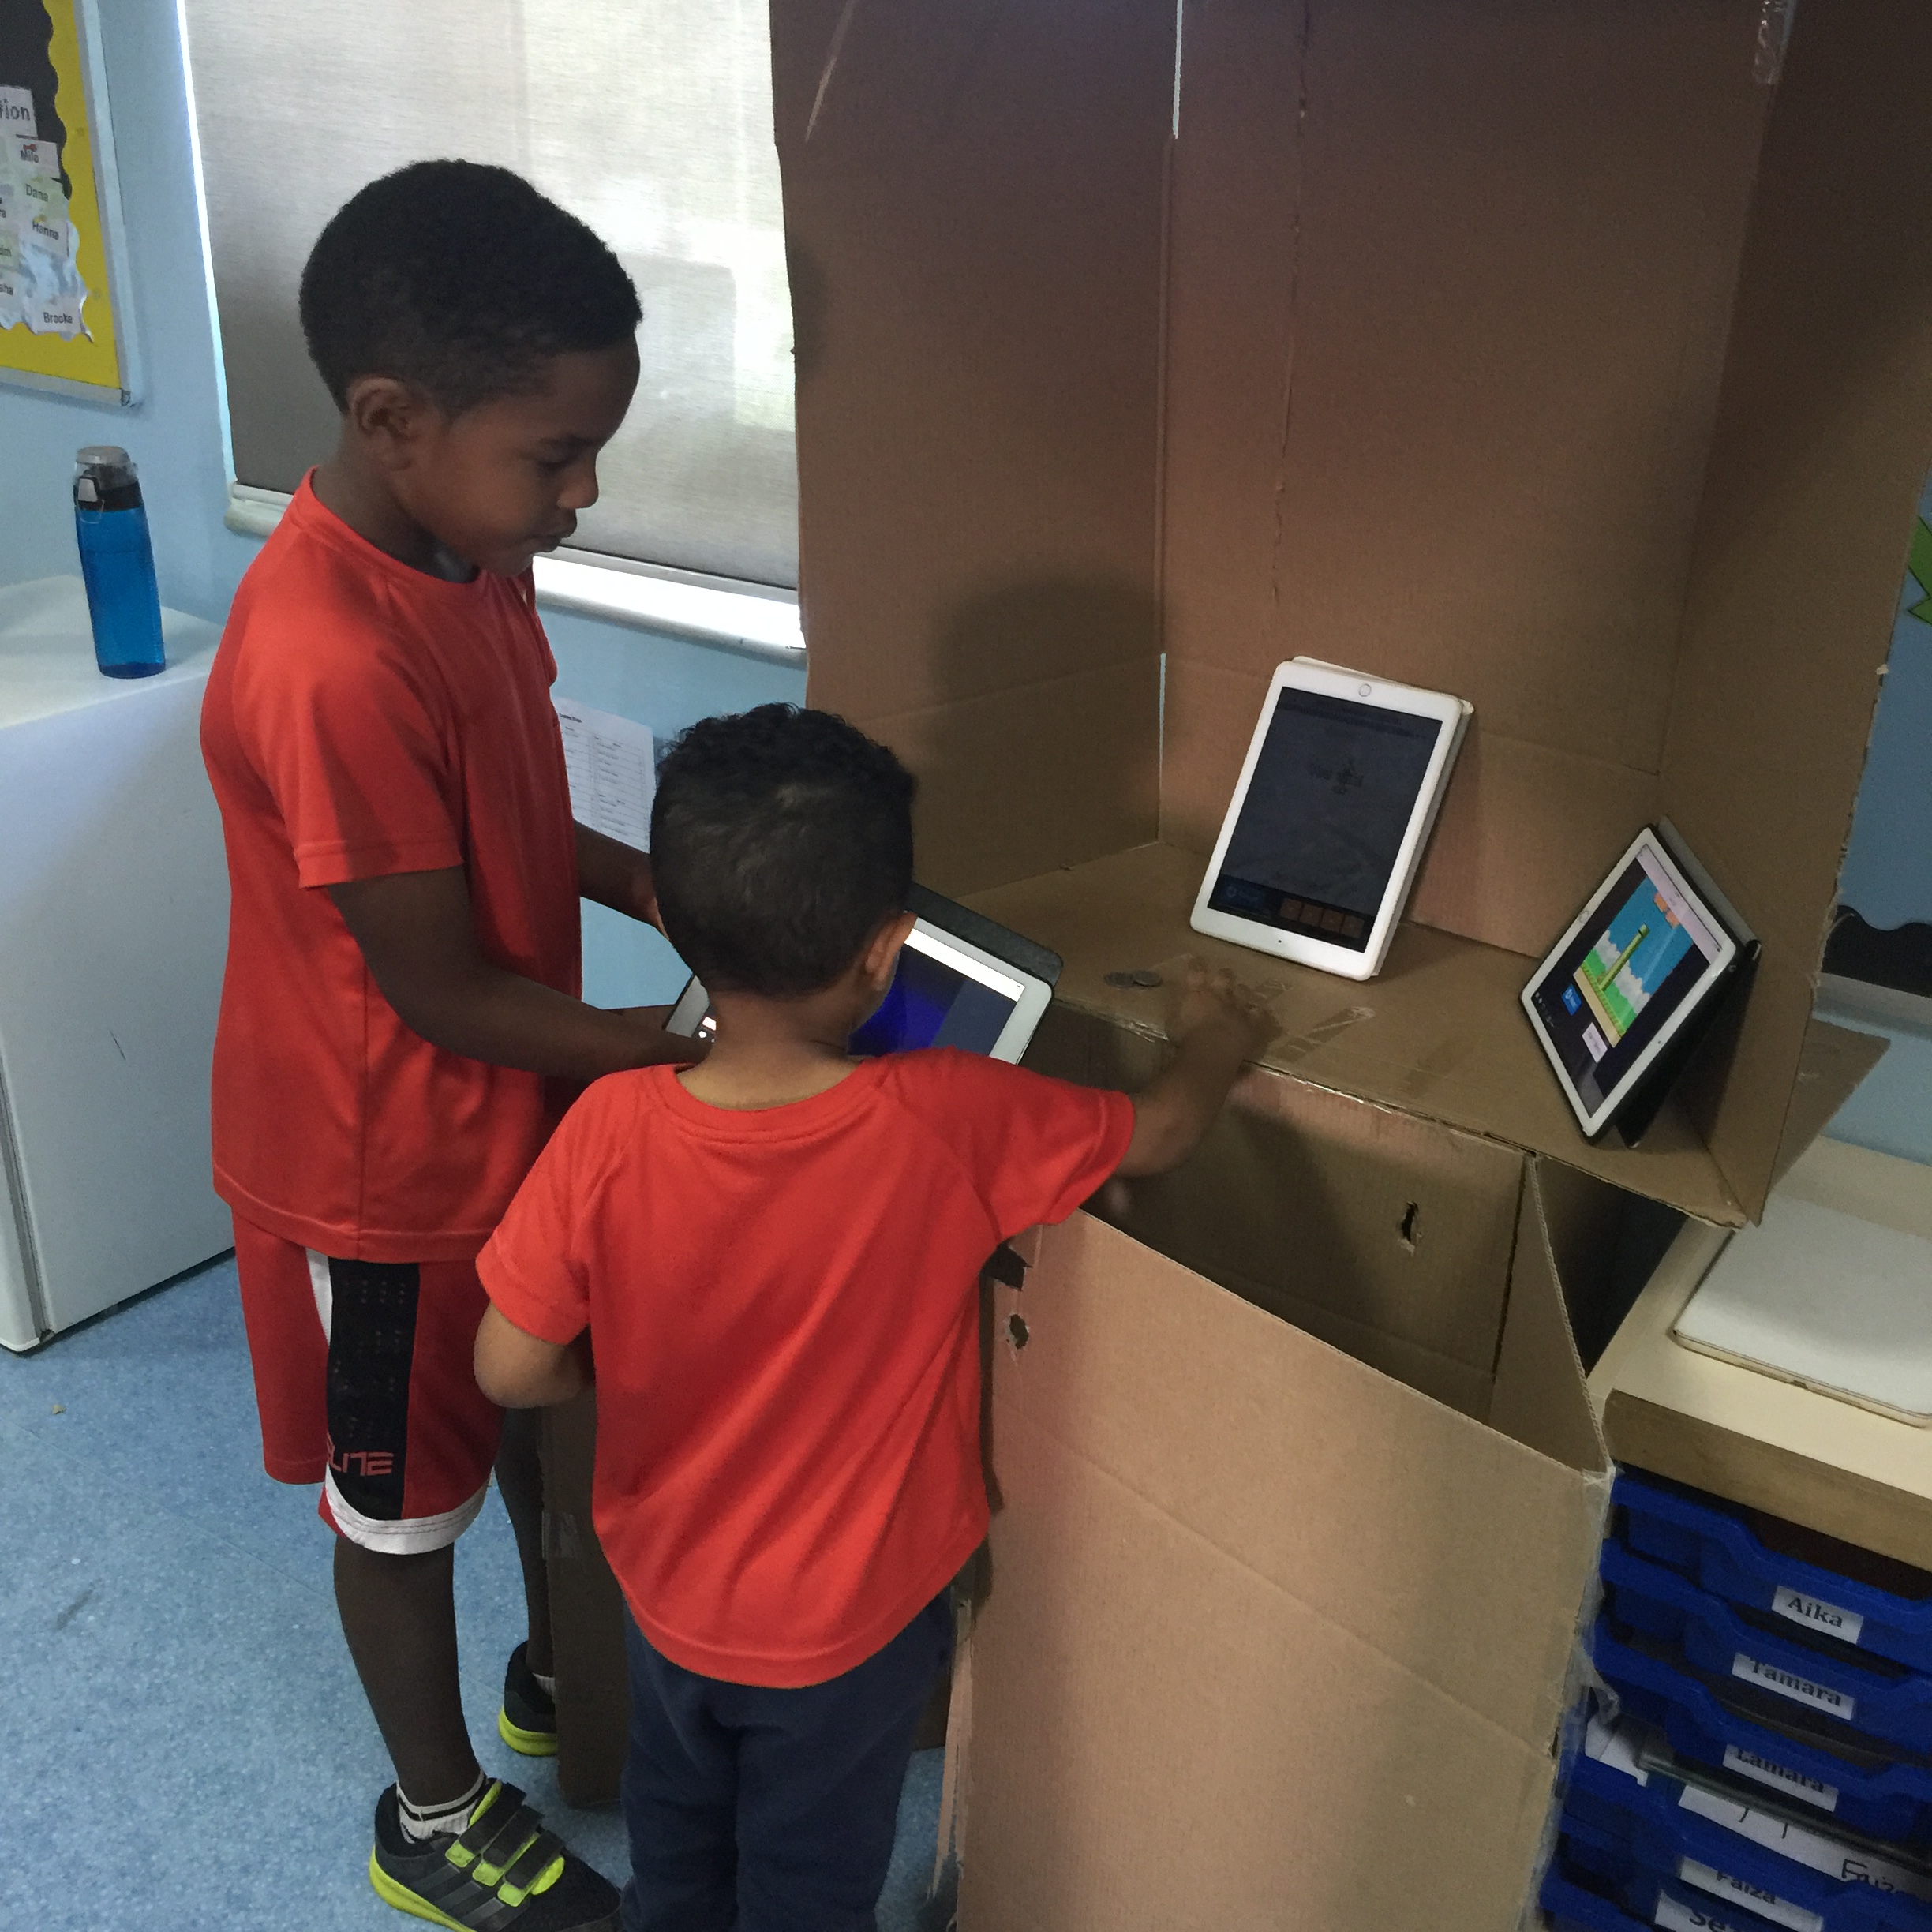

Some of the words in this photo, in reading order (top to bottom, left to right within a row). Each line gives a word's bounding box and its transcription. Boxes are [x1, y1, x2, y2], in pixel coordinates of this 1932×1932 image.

[26, 183, 48, 202] Dana
[32, 220, 59, 240] Hanna
[43, 312, 73, 324] Brooke
[1788, 1597, 1843, 1628] Aika
[1750, 1657, 1841, 1706] Tamara
